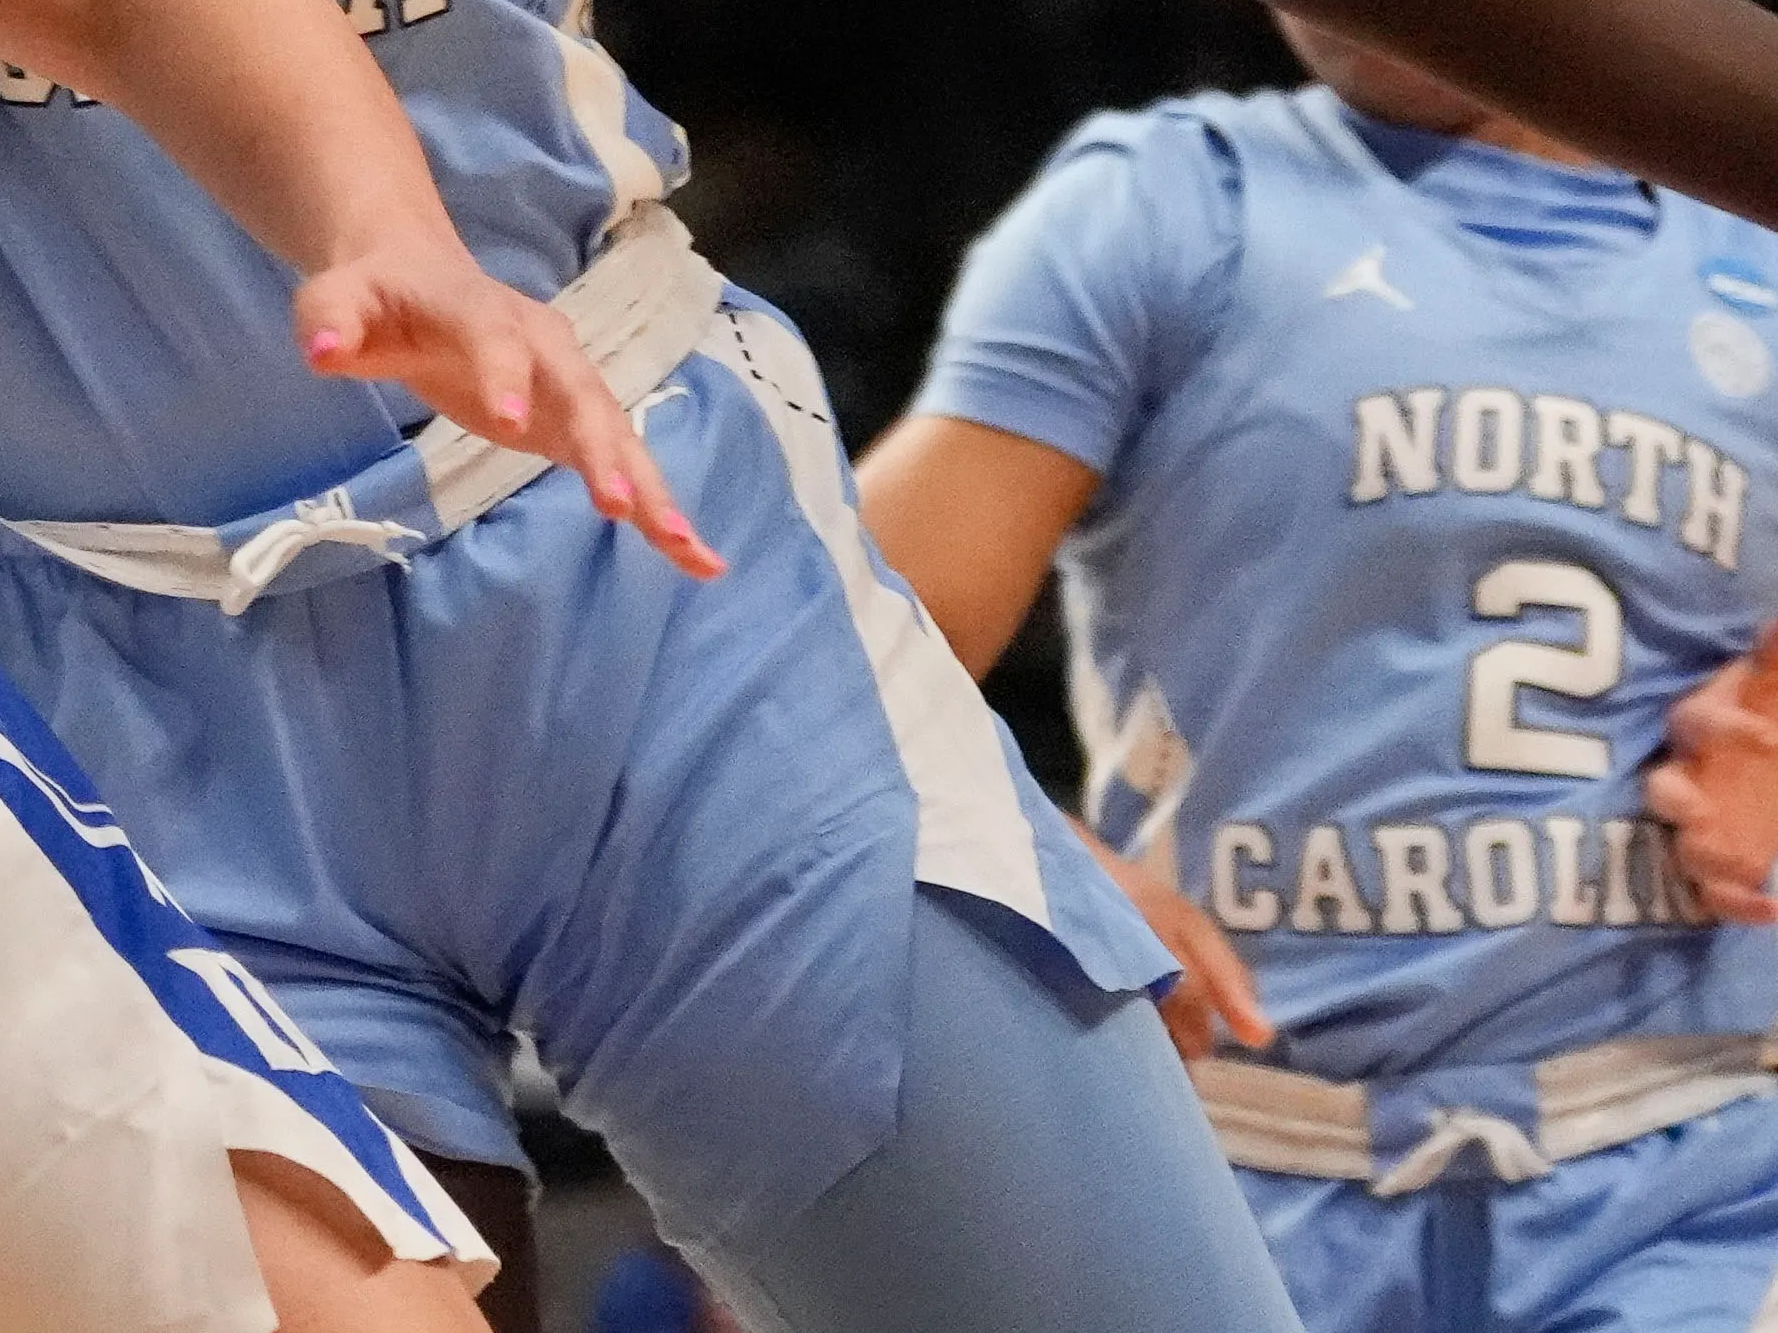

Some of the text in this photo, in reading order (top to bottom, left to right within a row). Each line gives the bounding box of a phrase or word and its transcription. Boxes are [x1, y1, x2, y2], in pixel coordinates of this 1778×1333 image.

[1349, 387, 1748, 570] NORTH
[1465, 560, 1623, 780] 2
[1211, 817, 1715, 934] CAROLIN
